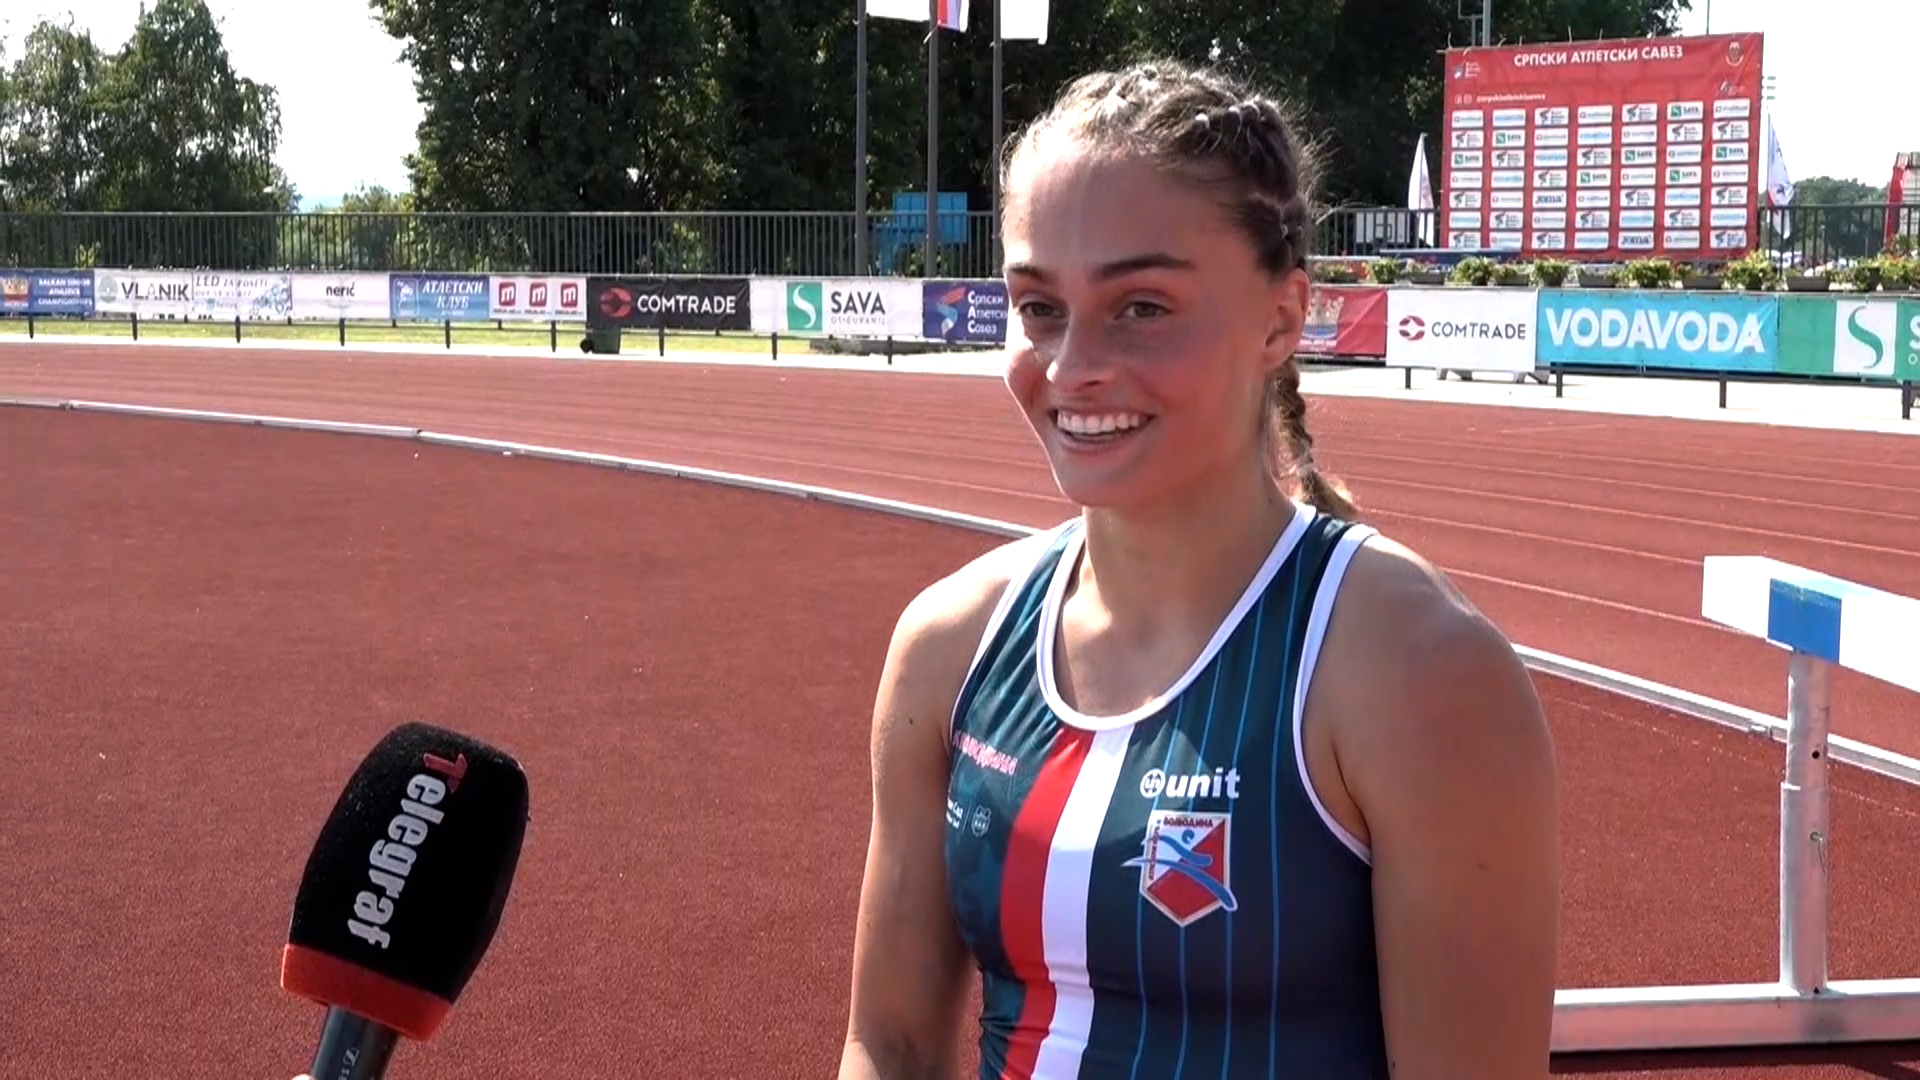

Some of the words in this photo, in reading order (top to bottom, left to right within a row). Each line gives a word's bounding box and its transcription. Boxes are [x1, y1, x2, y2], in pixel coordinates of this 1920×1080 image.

[1514, 51, 1567, 67] СРПСКИ
[1570, 49, 1639, 64] АТЛЕТСКИ
[1641, 45, 1683, 59] САВЕЗ
[121, 281, 190, 301] VLANIK
[422, 279, 484, 294] АТЛЕТСКИ
[436, 295, 469, 310] КЛУБ
[637, 294, 737, 314] COMTRADE
[831, 291, 886, 315] SAVA
[1431, 321, 1527, 340] COMTRADE
[1545, 307, 1767, 353] VODAVODA
[1165, 767, 1241, 799] unit
[347, 753, 468, 949] Telegraf
